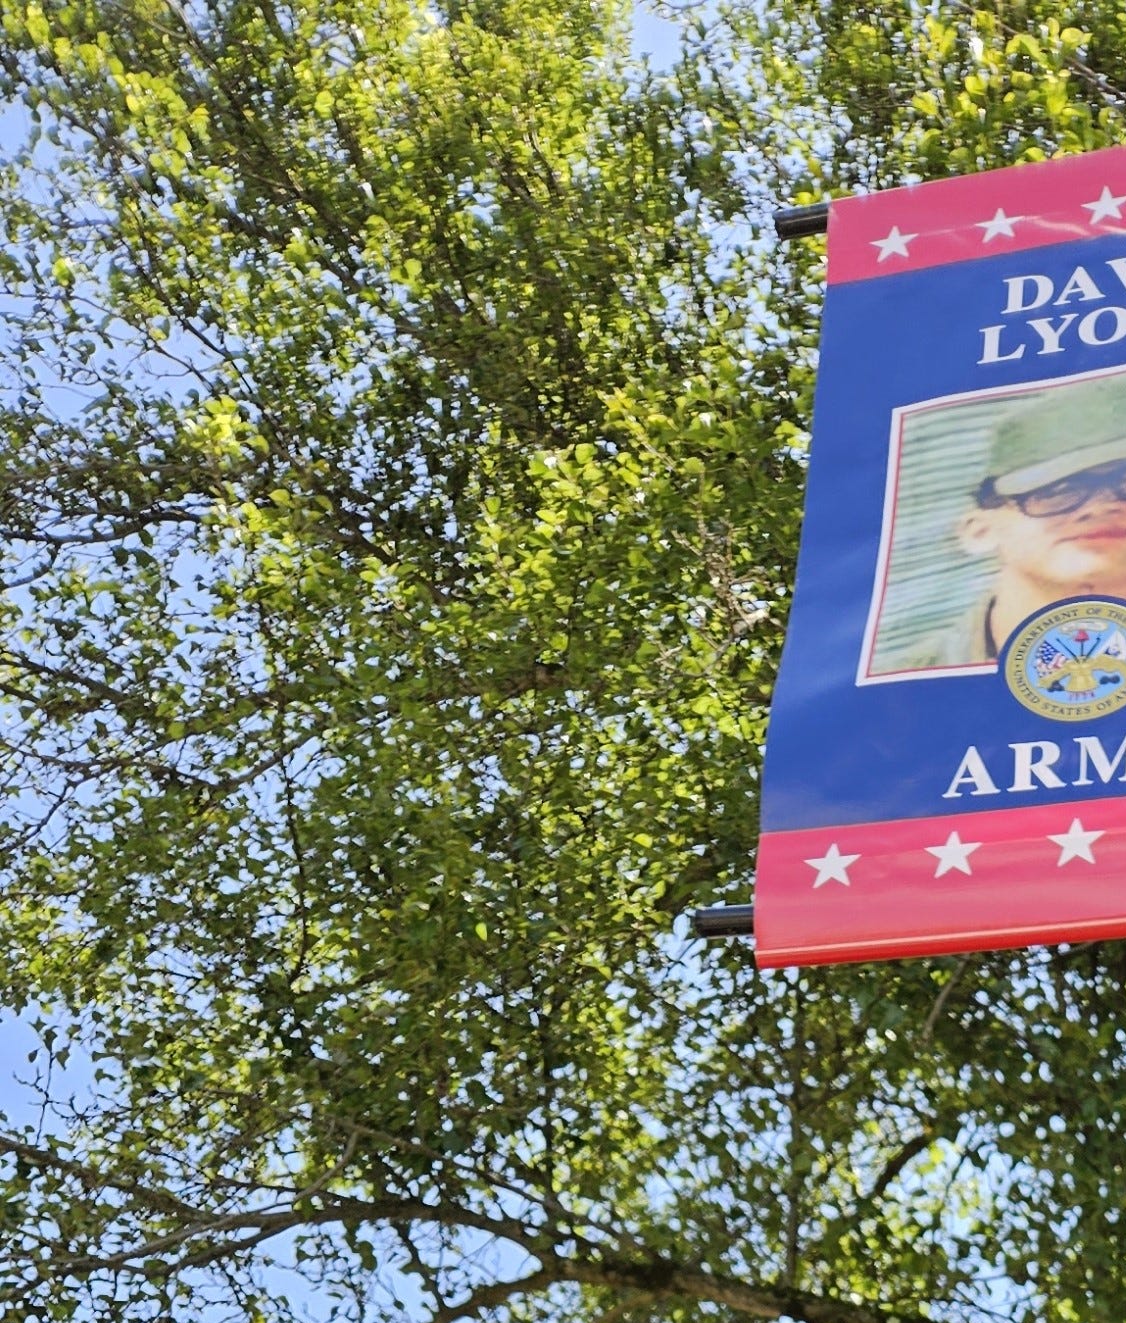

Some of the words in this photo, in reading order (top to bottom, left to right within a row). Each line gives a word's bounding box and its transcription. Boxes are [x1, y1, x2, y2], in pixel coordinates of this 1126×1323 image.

[1015, 608, 1079, 662] DEPARTMENT
[1086, 606, 1102, 616] OF
[1014, 669, 1041, 705] UNITED
[1042, 701, 1092, 716] STATES
[1096, 699, 1112, 712] OF
